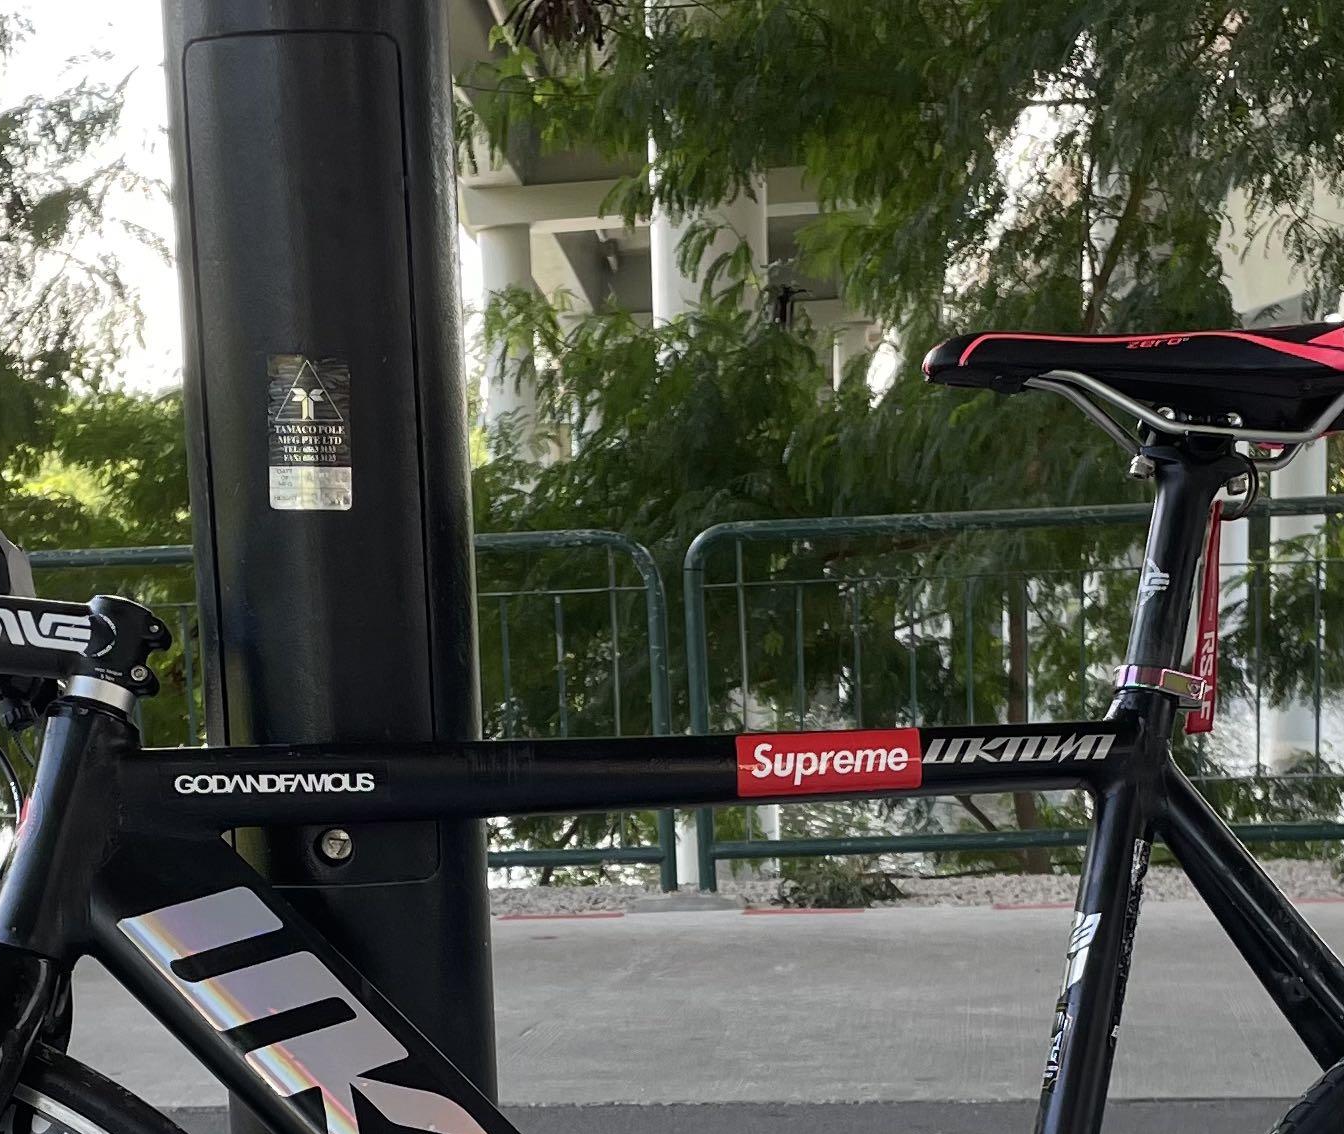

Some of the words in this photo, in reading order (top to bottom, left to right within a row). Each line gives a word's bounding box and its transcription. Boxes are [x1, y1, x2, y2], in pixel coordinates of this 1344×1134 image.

[274, 425, 316, 434] TAMACO
[318, 425, 345, 434] POLE
[302, 435, 320, 445] PTE
[322, 435, 342, 445] LTD
[751, 743, 909, 786] Supreme
[174, 772, 375, 794] GODANDFAMOUS
